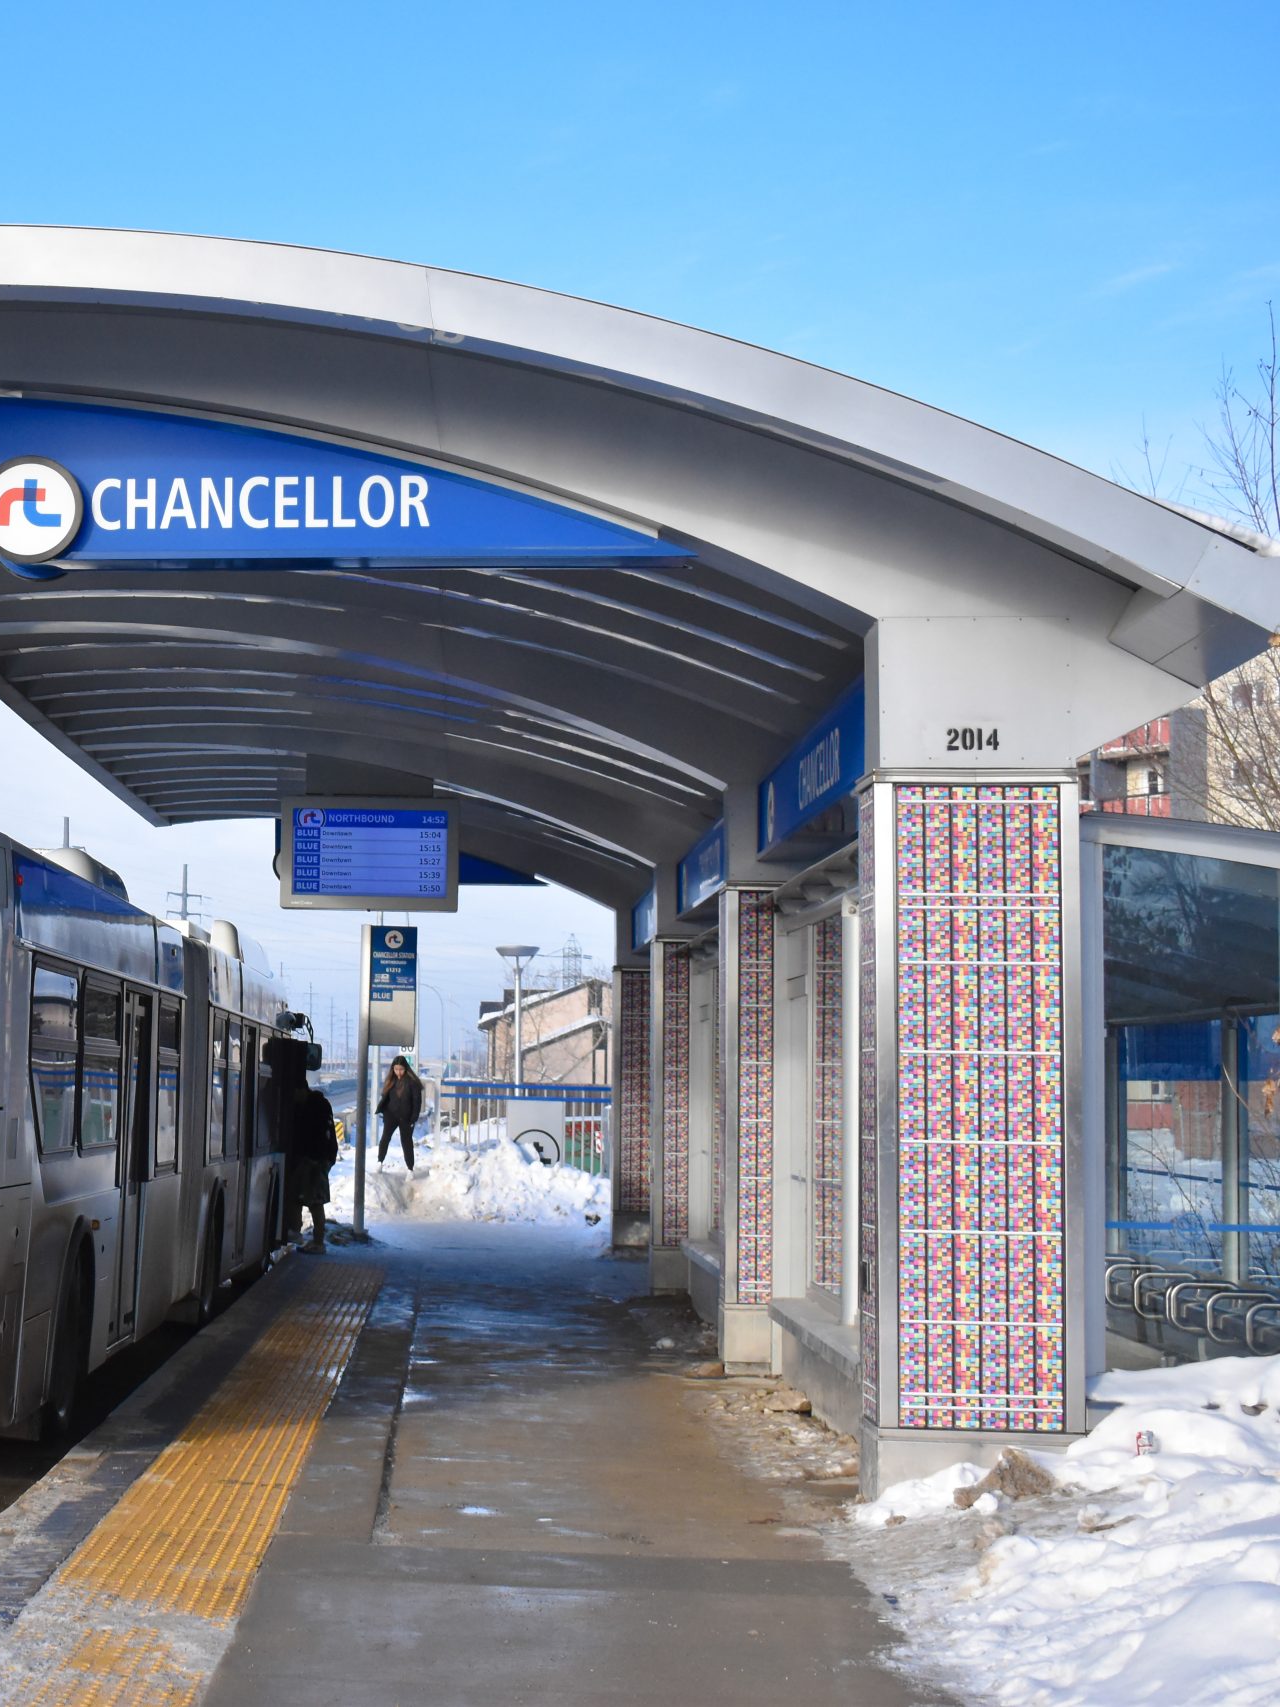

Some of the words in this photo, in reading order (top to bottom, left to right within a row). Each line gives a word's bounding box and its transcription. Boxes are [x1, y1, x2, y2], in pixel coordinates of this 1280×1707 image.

[91, 474, 431, 531] CHANCELLOR
[946, 727, 999, 751] 2014
[798, 728, 840, 811] CHANCELLOR
[328, 814, 395, 824] NORTHBOUND
[422, 815, 445, 824] 14:52
[297, 829, 319, 837] BLUE
[419, 831, 441, 839] 15:04
[297, 842, 318, 850] BLUE
[419, 844, 441, 852] 15:15
[296, 855, 318, 864] BLUE
[321, 856, 352, 864] Downtown
[419, 858, 441, 866] 15:27
[296, 868, 318, 877] BLUE
[418, 871, 440, 879] 15:39
[296, 882, 317, 890] BLUE
[418, 884, 440, 893] 15:50
